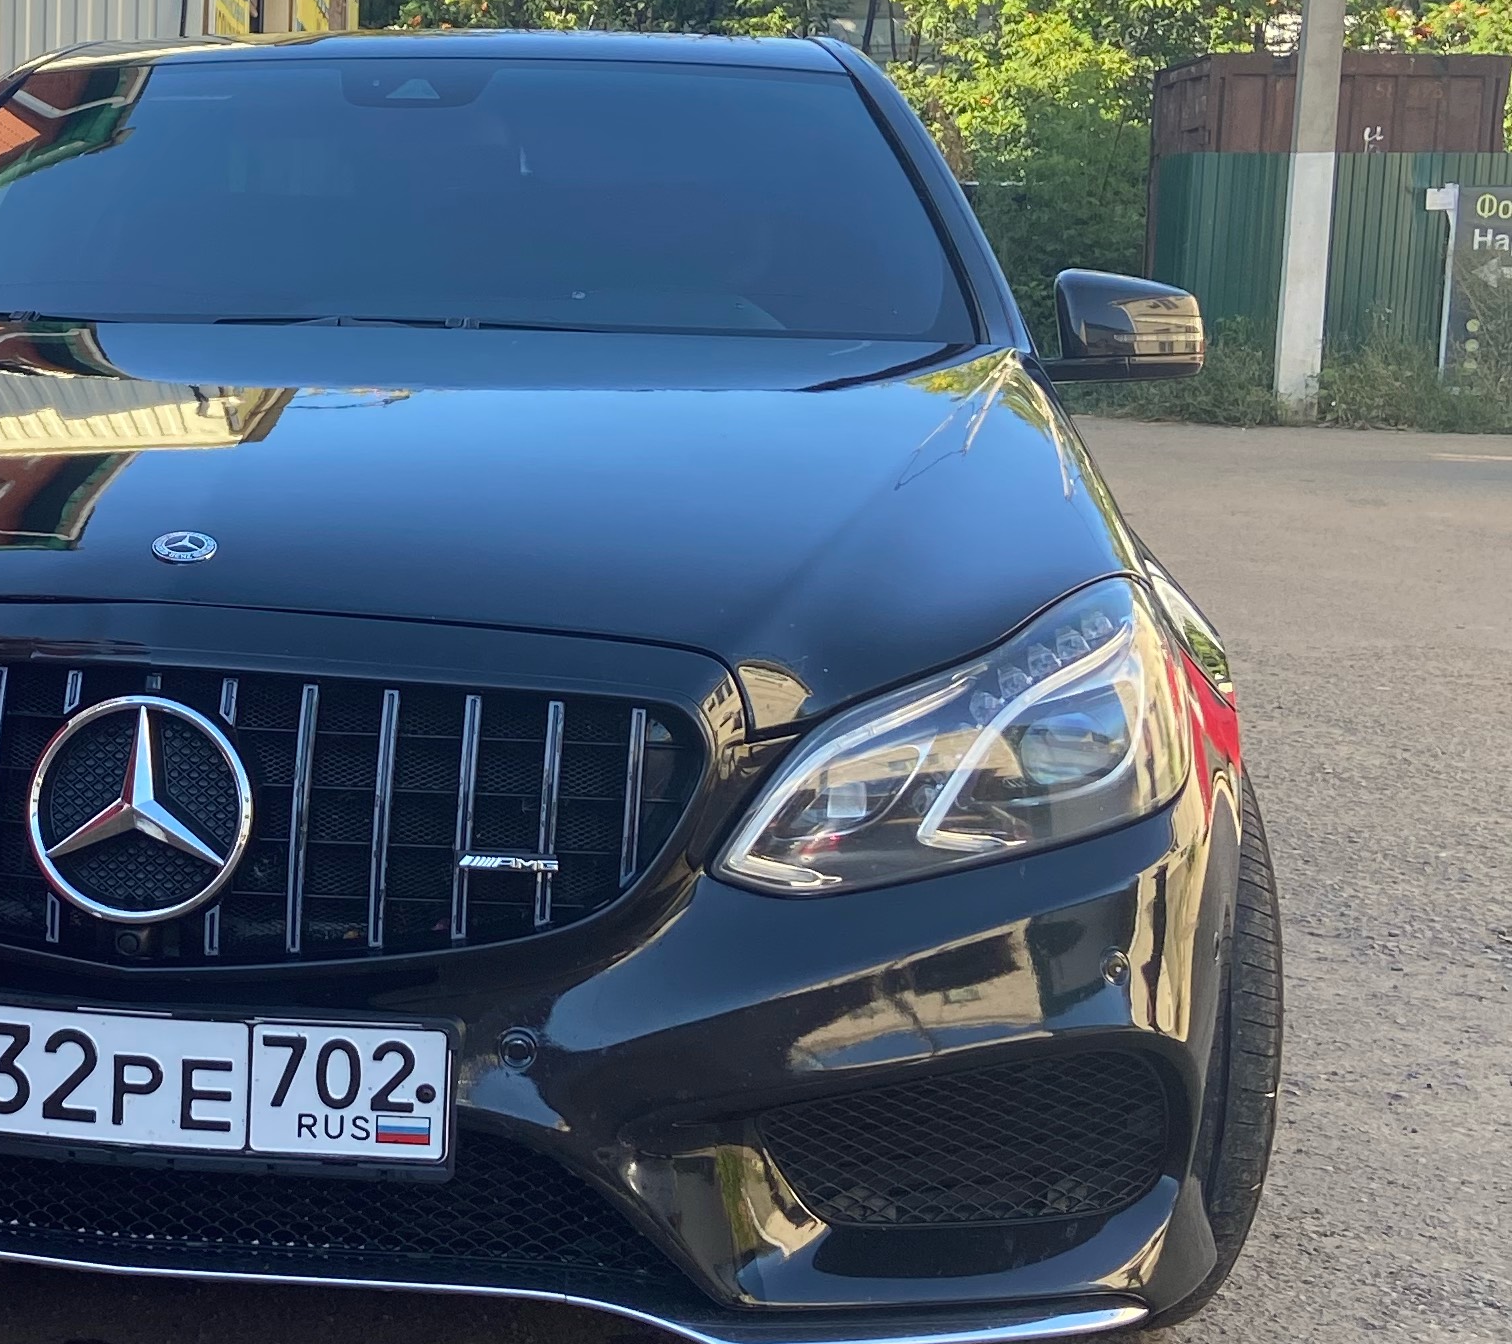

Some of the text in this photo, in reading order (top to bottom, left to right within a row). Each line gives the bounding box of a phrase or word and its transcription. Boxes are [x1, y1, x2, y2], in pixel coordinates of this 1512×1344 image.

[1472, 228, 1512, 256] На
[494, 856, 559, 871] AMG
[261, 1034, 416, 1114] 702
[296, 1112, 371, 1141] RUS
